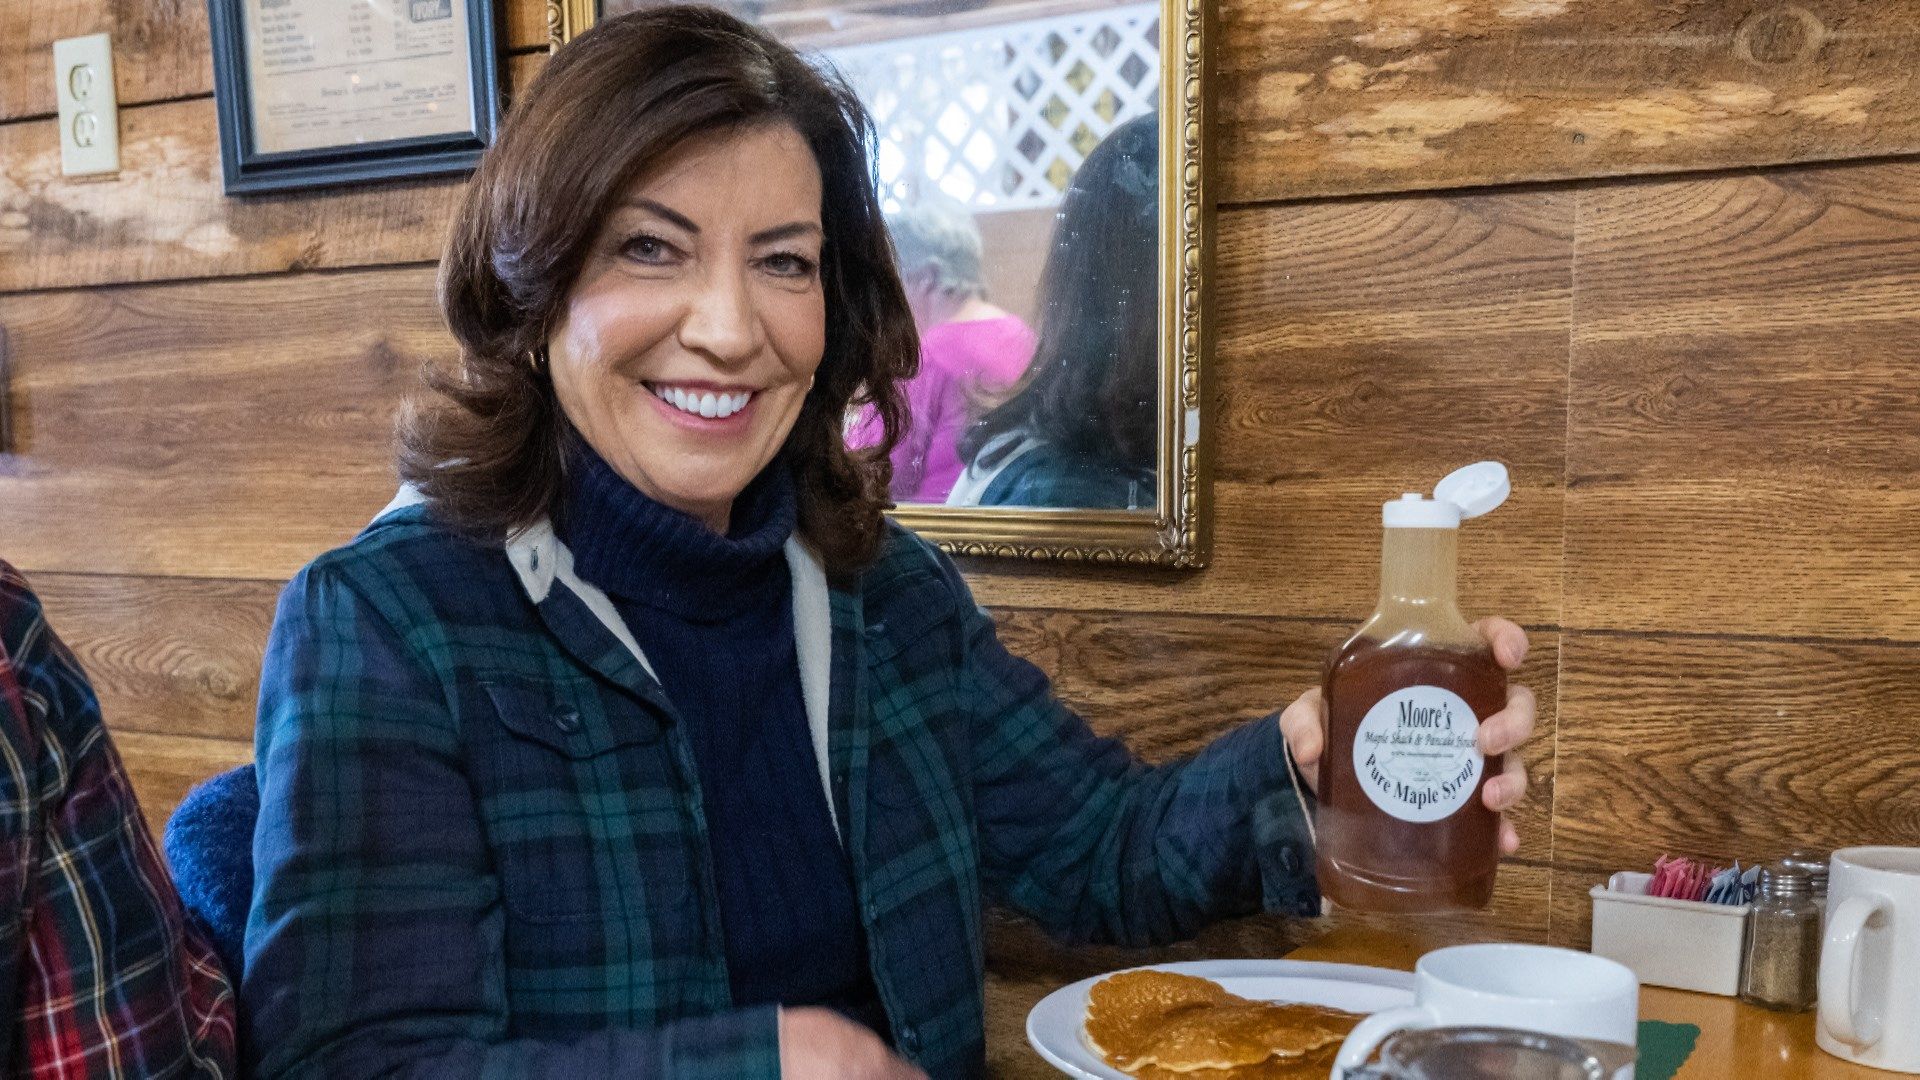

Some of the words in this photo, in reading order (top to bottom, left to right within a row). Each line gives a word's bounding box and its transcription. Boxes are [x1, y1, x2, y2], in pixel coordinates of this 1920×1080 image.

[1398, 699, 1453, 730] Moore's
[1364, 728, 1389, 749] Maple
[1390, 730, 1414, 745] Shack
[1414, 734, 1423, 746] &
[1425, 732, 1455, 746] Pancake
[1364, 753, 1392, 794] Pure
[1392, 781, 1440, 810] Maple
[1441, 757, 1474, 800] Syrup
